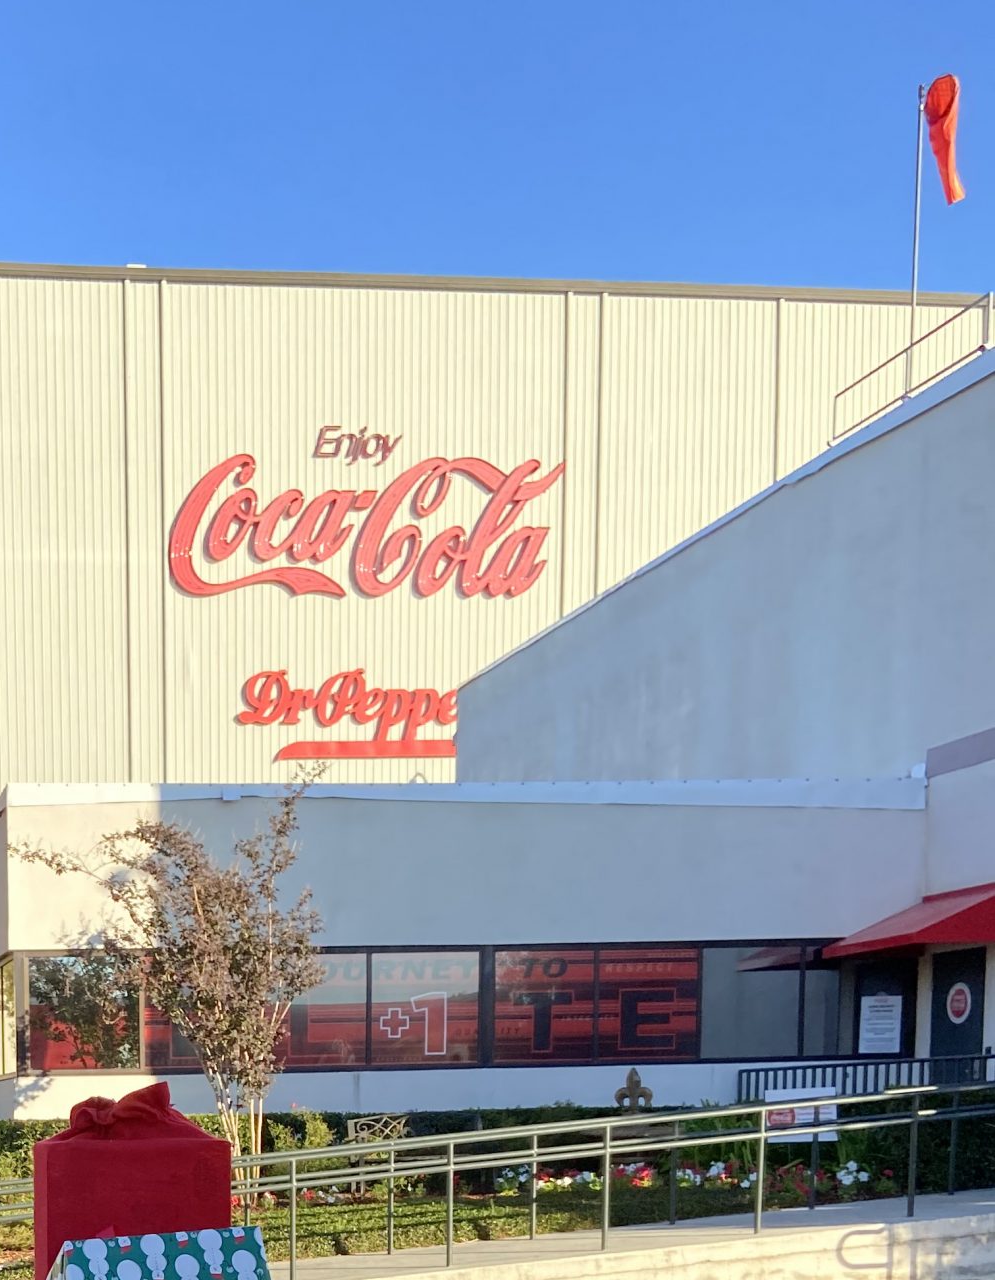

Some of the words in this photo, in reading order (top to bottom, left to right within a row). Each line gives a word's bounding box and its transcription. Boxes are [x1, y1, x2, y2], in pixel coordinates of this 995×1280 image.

[312, 425, 402, 467] Enjoy
[169, 453, 566, 598] Coca-Cola
[236, 669, 315, 726] Dr
[315, 668, 458, 741] Peppe
[320, 958, 479, 982] OURNEY
[519, 957, 569, 978] TO
